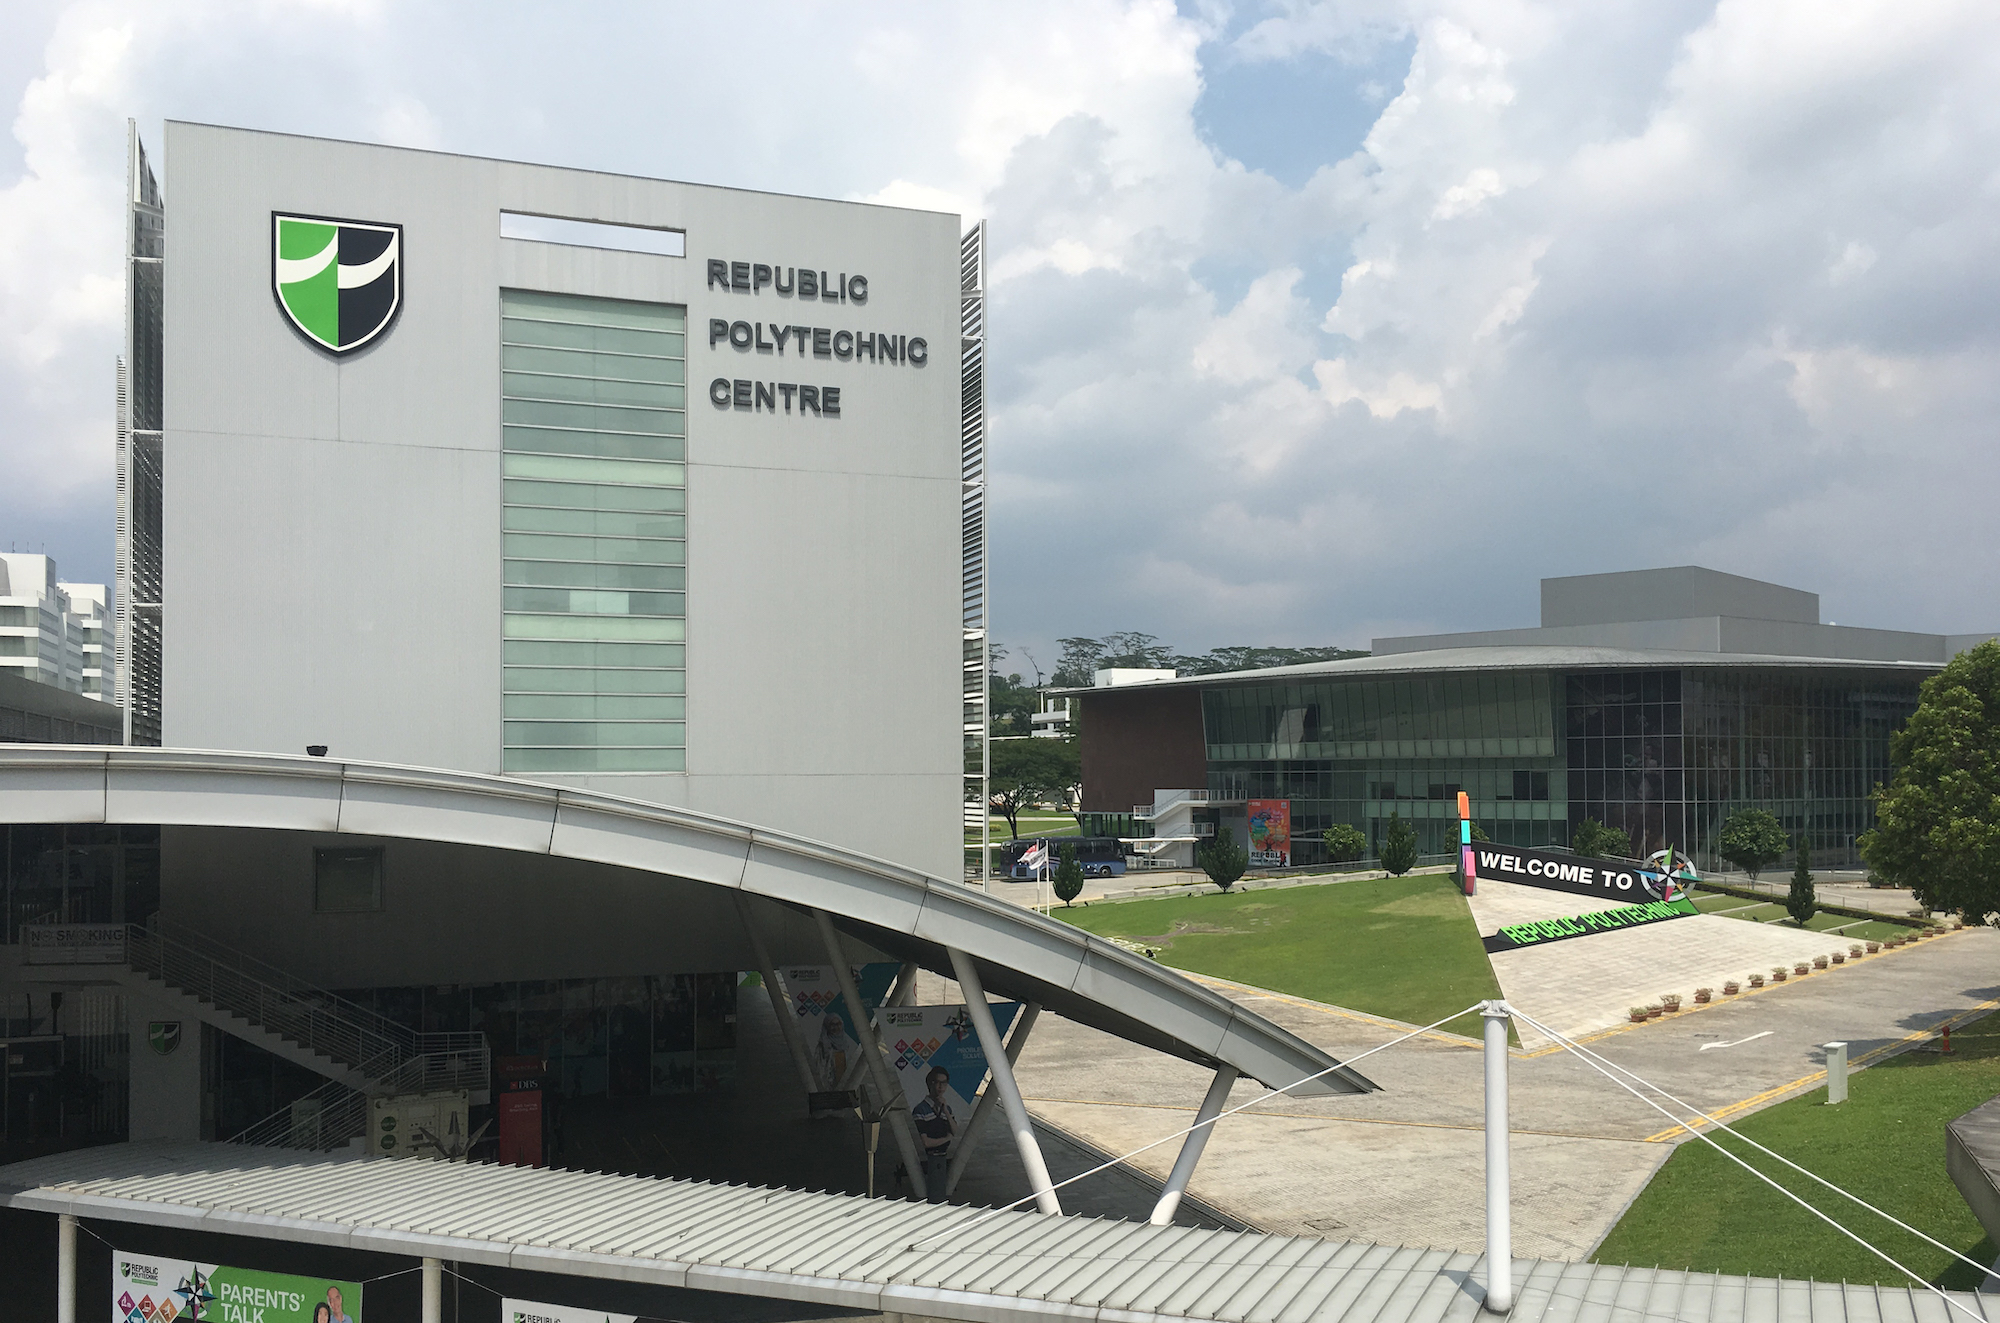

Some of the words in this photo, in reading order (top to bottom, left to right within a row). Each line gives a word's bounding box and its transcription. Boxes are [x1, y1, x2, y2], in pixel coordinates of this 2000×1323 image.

[707, 258, 868, 300] REPUBLIC
[709, 317, 928, 363] POLYTECHNIC
[709, 377, 840, 413] CENTRE
[1480, 850, 1593, 886] WELCOME
[1601, 869, 1633, 891] TO
[1501, 915, 1587, 945] REPUBLIC
[1580, 899, 1681, 931] POLYTECHNIC
[518, 1079, 538, 1089] DBS
[220, 1302, 265, 1323] TALK
